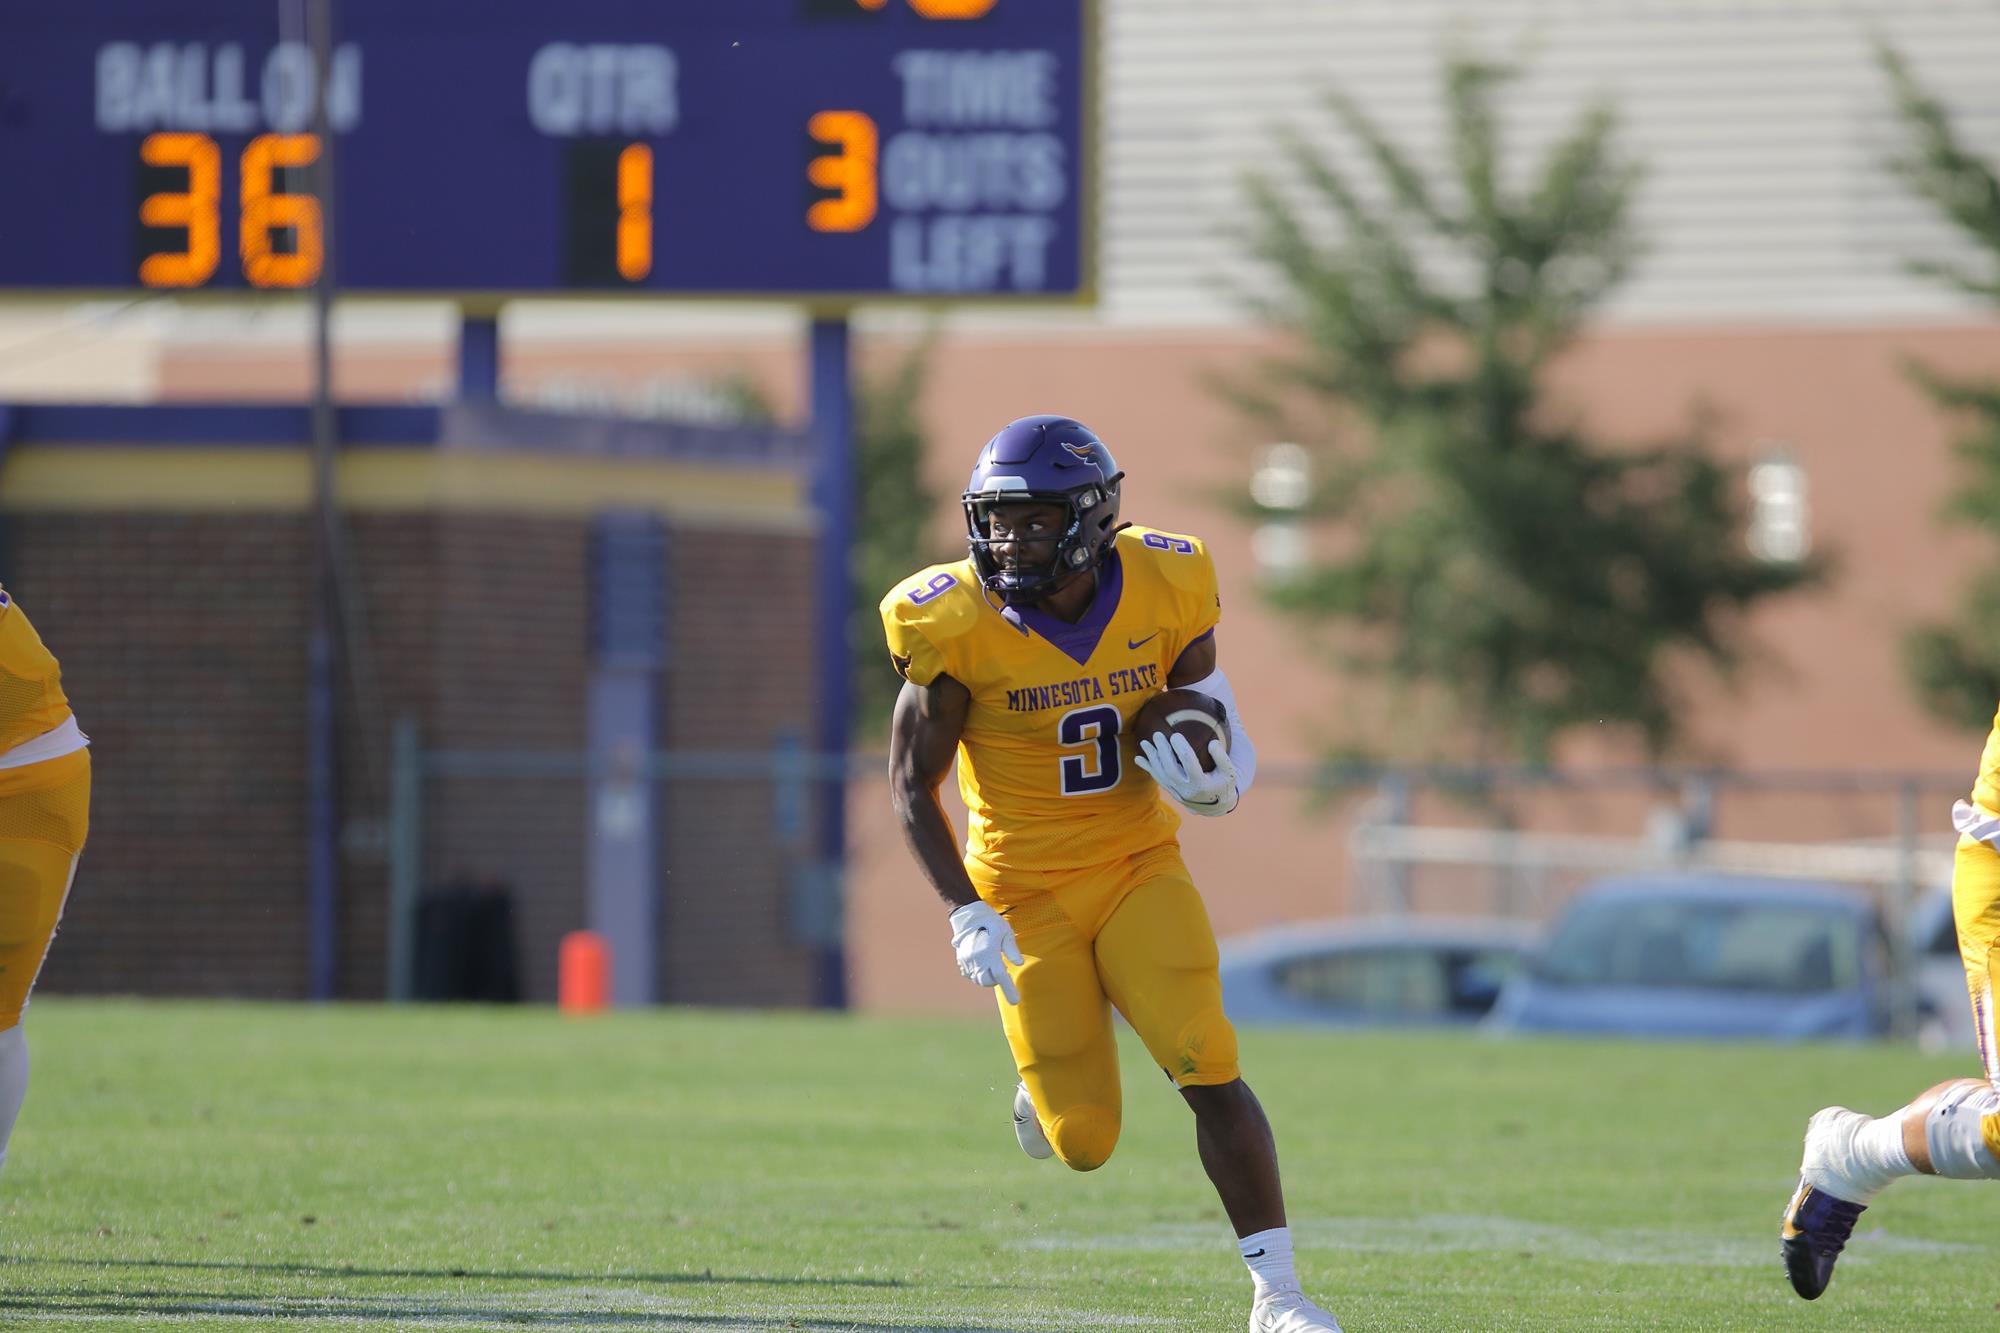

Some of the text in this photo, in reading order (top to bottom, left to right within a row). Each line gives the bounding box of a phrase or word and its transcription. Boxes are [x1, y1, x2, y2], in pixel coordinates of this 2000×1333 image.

[95, 41, 258, 133] BALL
[528, 41, 681, 137] QTR
[891, 49, 1060, 127] TIME
[138, 131, 325, 288] 36
[616, 141, 654, 281] 1
[805, 110, 879, 233] 3
[882, 130, 1066, 212] OUTS
[889, 215, 1057, 291] LEFT
[907, 572, 958, 606] 9
[1006, 663, 1158, 712] MINNESOTA STATE
